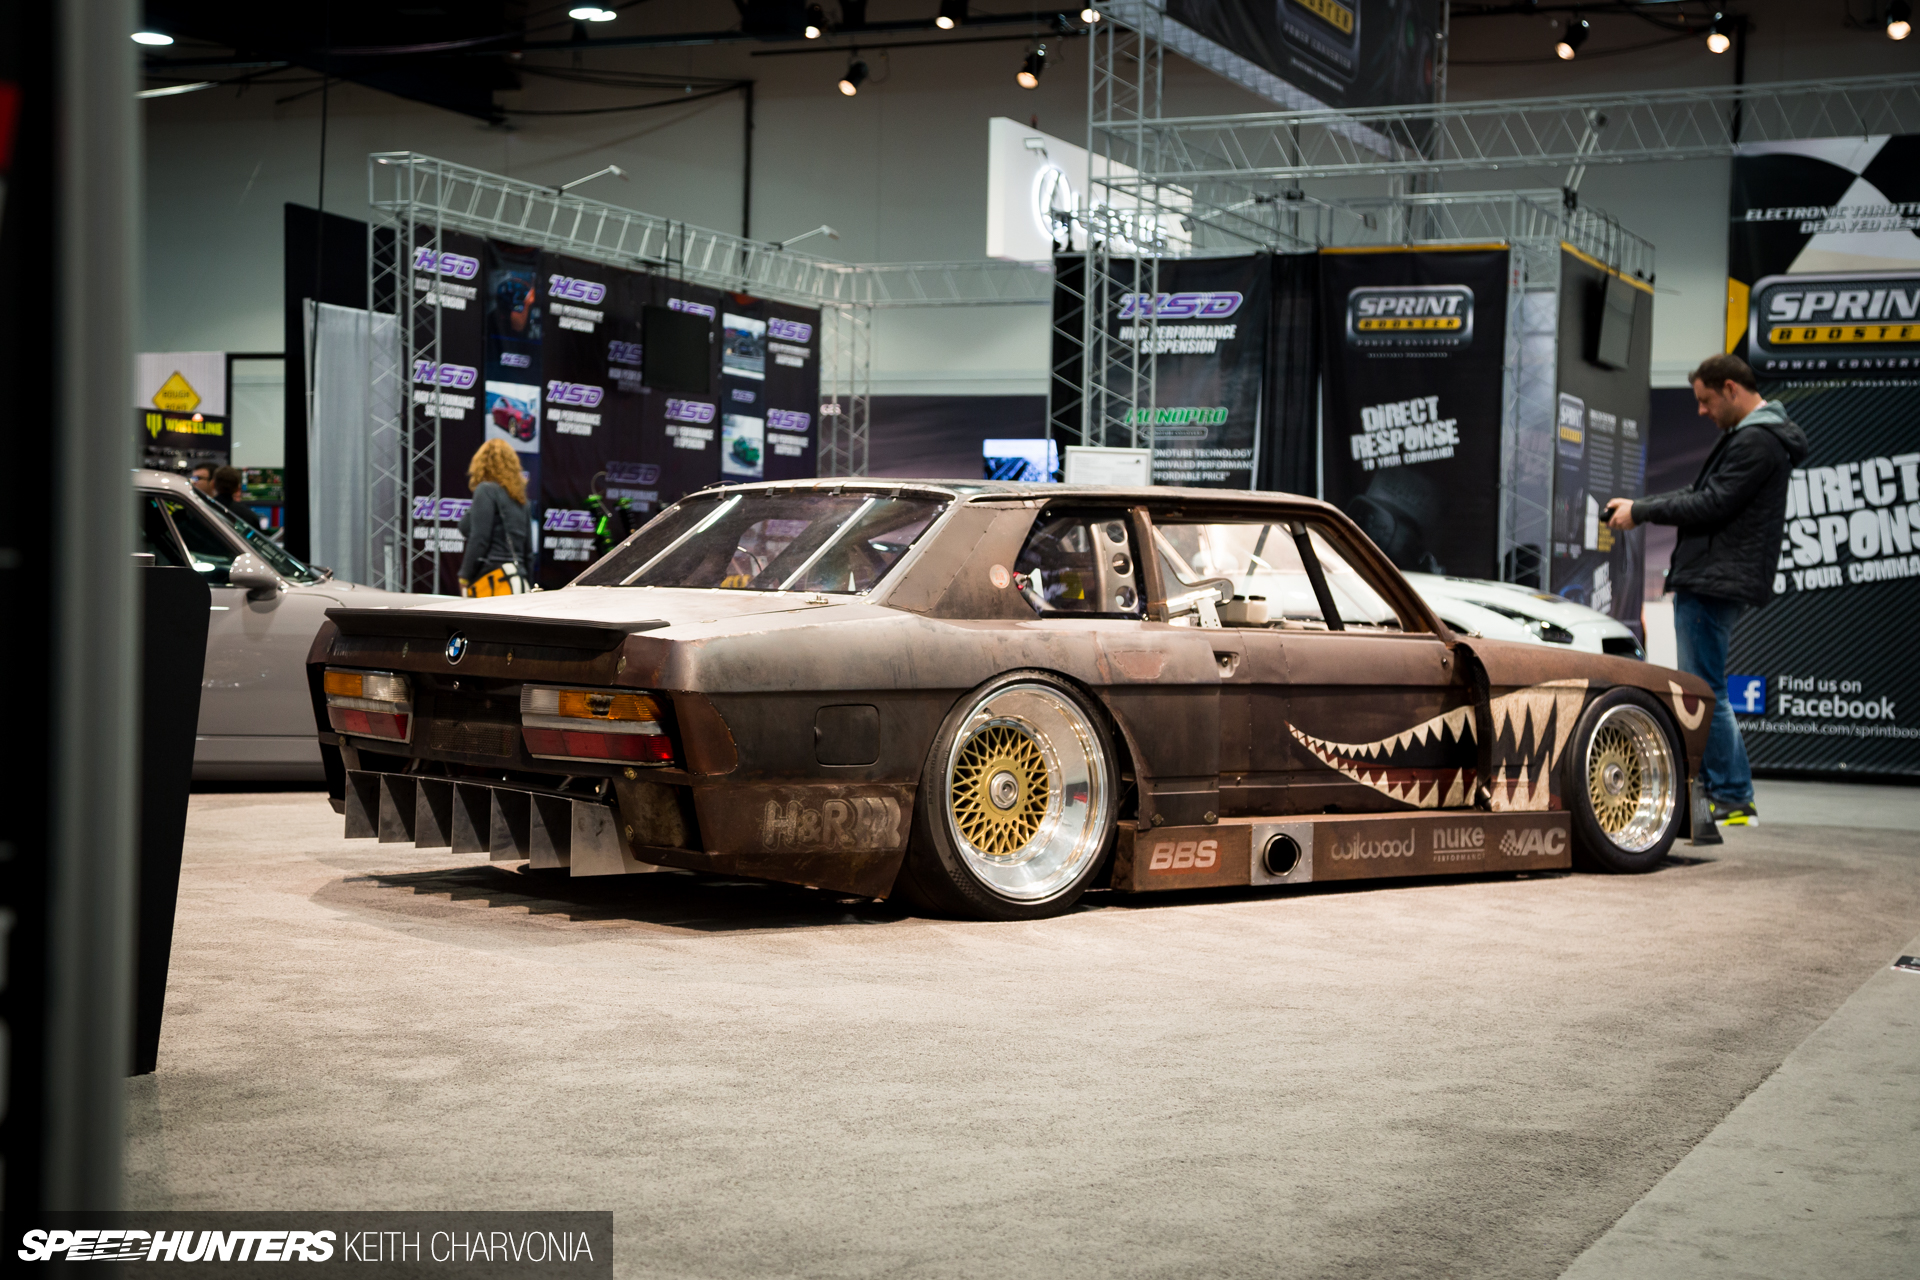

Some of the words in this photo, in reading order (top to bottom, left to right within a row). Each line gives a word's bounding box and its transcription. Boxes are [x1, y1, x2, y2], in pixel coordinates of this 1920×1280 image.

[1746, 206, 1850, 223] ELECTRONIC
[1801, 220, 1882, 235] DELAYED
[413, 247, 480, 280] HSD
[548, 273, 607, 305] HSD
[1117, 291, 1243, 319] HSD
[1357, 295, 1464, 317] SPRINT
[1768, 288, 1920, 321] SPRIN
[767, 317, 812, 343] HSD
[1119, 326, 1149, 340] HIH
[1778, 325, 1914, 341] BOOSTE
[608, 340, 643, 365] HS
[1766, 359, 1828, 370] POWER
[412, 359, 478, 390] HSD
[546, 380, 604, 408] HSD
[664, 398, 716, 424] HSD
[766, 408, 811, 432] HSD
[1360, 395, 1440, 433] DIRECT
[165, 418, 224, 436] WHITELINE
[1350, 418, 1460, 462] RESPONSE
[1194, 448, 1253, 458] TECHNOLOGY
[1197, 459, 1255, 470] PERFORMANC
[1776, 501, 1920, 571] ESPONS
[1772, 571, 1787, 595] O
[1792, 565, 1844, 592] YOUR
[1778, 675, 1814, 692] Find
[1817, 680, 1835, 693] us
[1840, 680, 1862, 694] on
[1778, 694, 1896, 720] Facebook
[763, 799, 866, 850] H&R
[1331, 827, 1415, 860] wilwood
[1433, 827, 1485, 849] nuke
[1500, 827, 1566, 857] VAC
[1149, 840, 1219, 871] BBS
